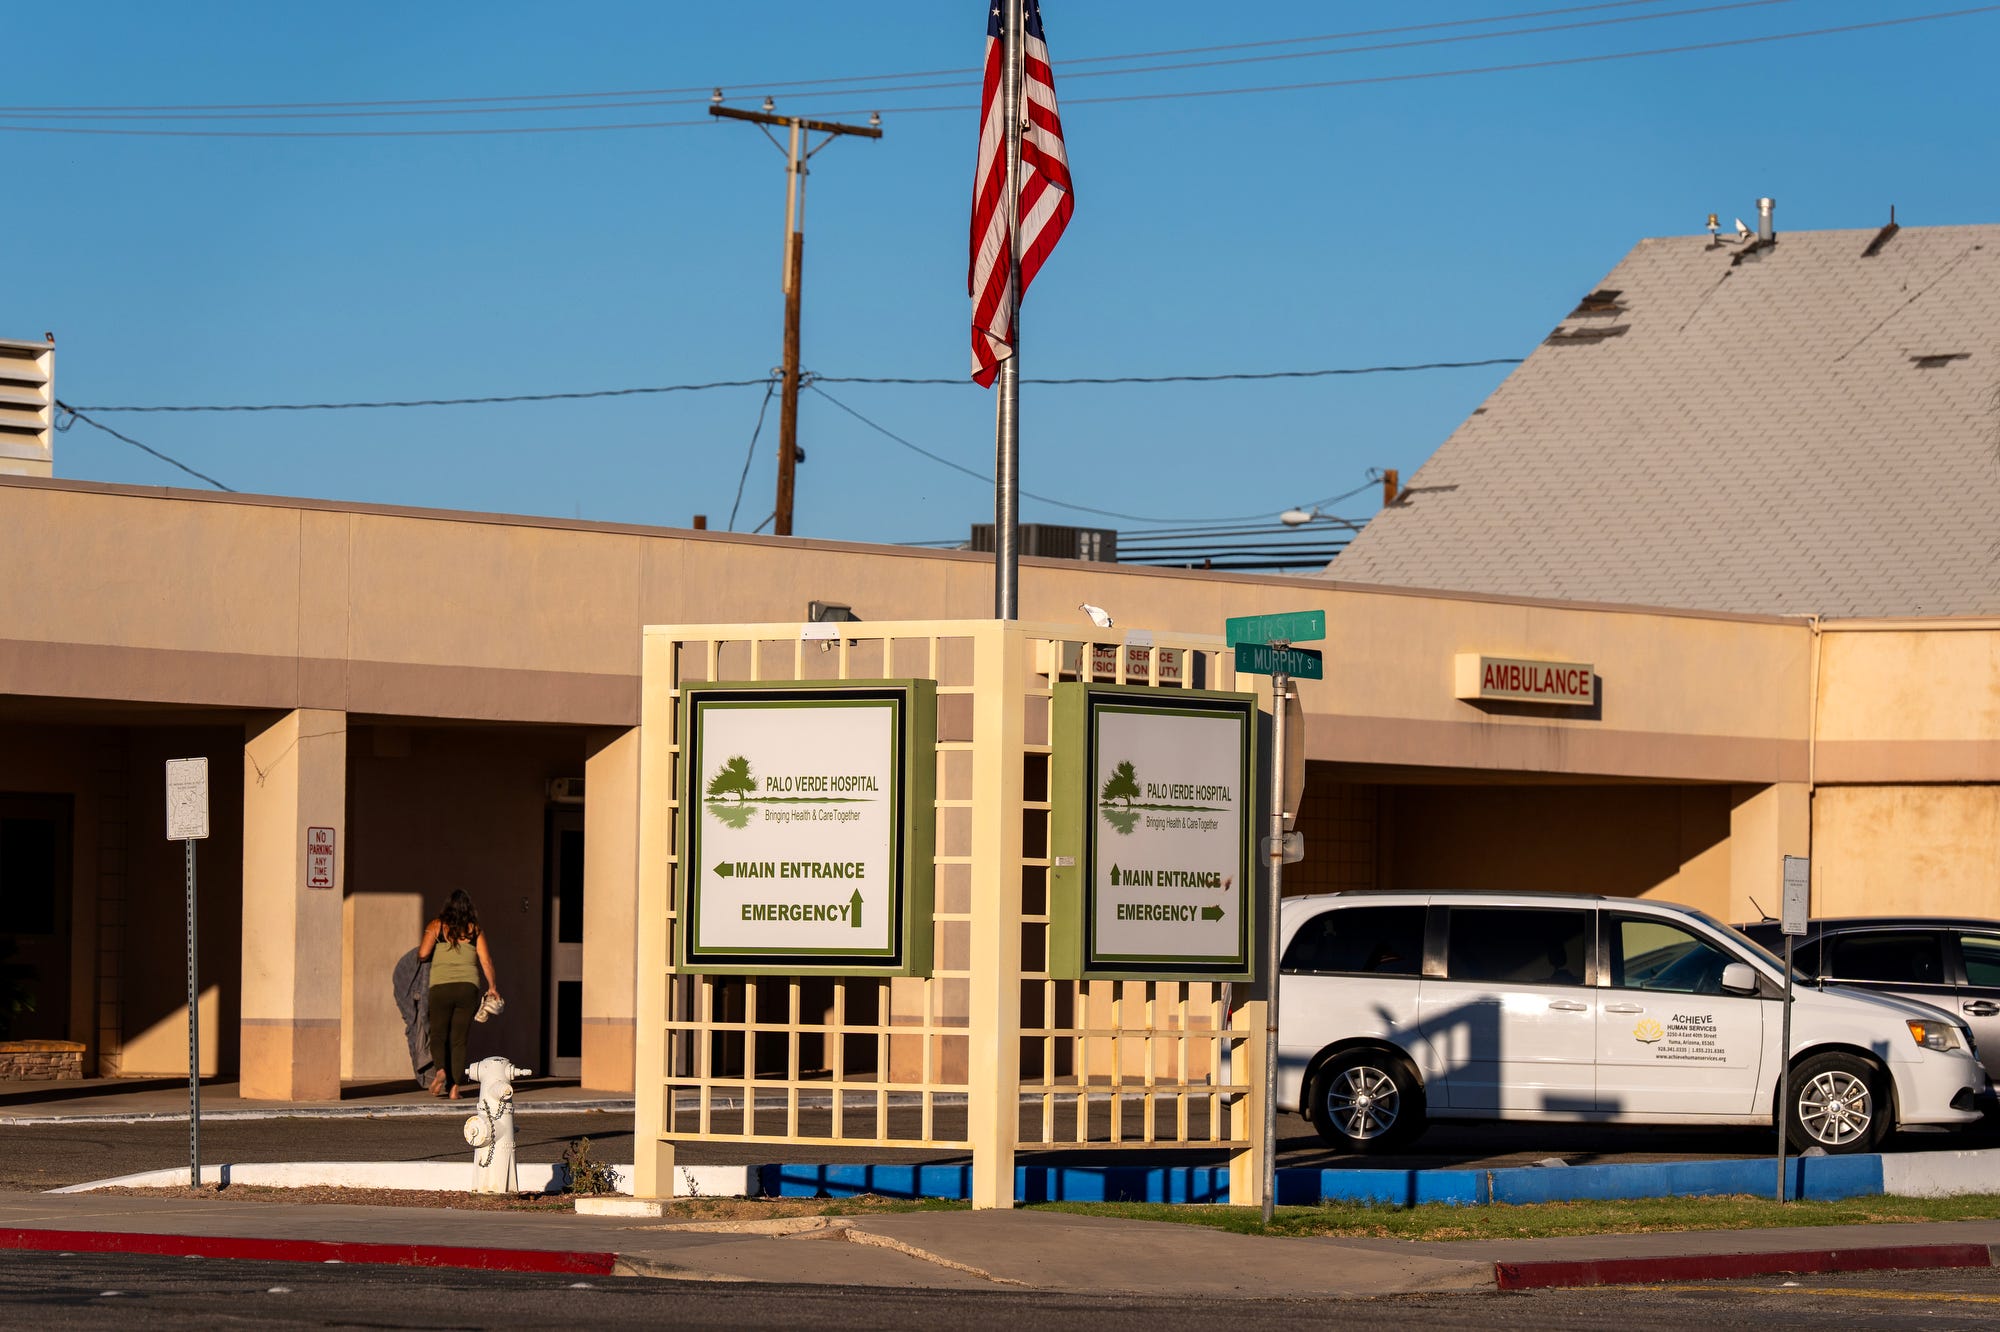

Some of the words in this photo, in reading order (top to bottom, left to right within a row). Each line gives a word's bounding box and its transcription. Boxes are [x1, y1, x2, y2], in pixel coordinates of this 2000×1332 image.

[1247, 617, 1299, 641] FIRST
[1129, 650, 1173, 663] SERCE
[1254, 648, 1304, 674] MURPHY
[1133, 664, 1148, 675] ON
[1156, 666, 1178, 677] UTY
[1483, 663, 1589, 696] AMBULANCE
[766, 776, 793, 792] PALO
[794, 776, 828, 792] VERDE
[830, 776, 879, 792] HOSPITAL
[1147, 783, 1168, 799] PALO
[1169, 784, 1194, 800] VERDE
[1195, 785, 1232, 802] HOSPITAL
[765, 809, 790, 824] Bringing
[791, 809, 811, 821] Health
[812, 809, 817, 820] &
[1146, 815, 1166, 831] Bringing
[1166, 816, 1181, 829] Health
[1182, 817, 1186, 828] &
[316, 831, 327, 843] NO
[309, 844, 333, 856] PARKING
[315, 857, 327, 867] ANY
[314, 866, 328, 876] TIME
[735, 862, 775, 878] MAIN
[780, 862, 865, 879] ENTRANCE
[1122, 869, 1154, 887] MAIN
[1156, 870, 1222, 889] ENTRANCE
[741, 904, 850, 922] EMERGENCY
[1117, 903, 1198, 922] EMERGENCY
[1672, 1014, 1712, 1024] ACHIEVE
